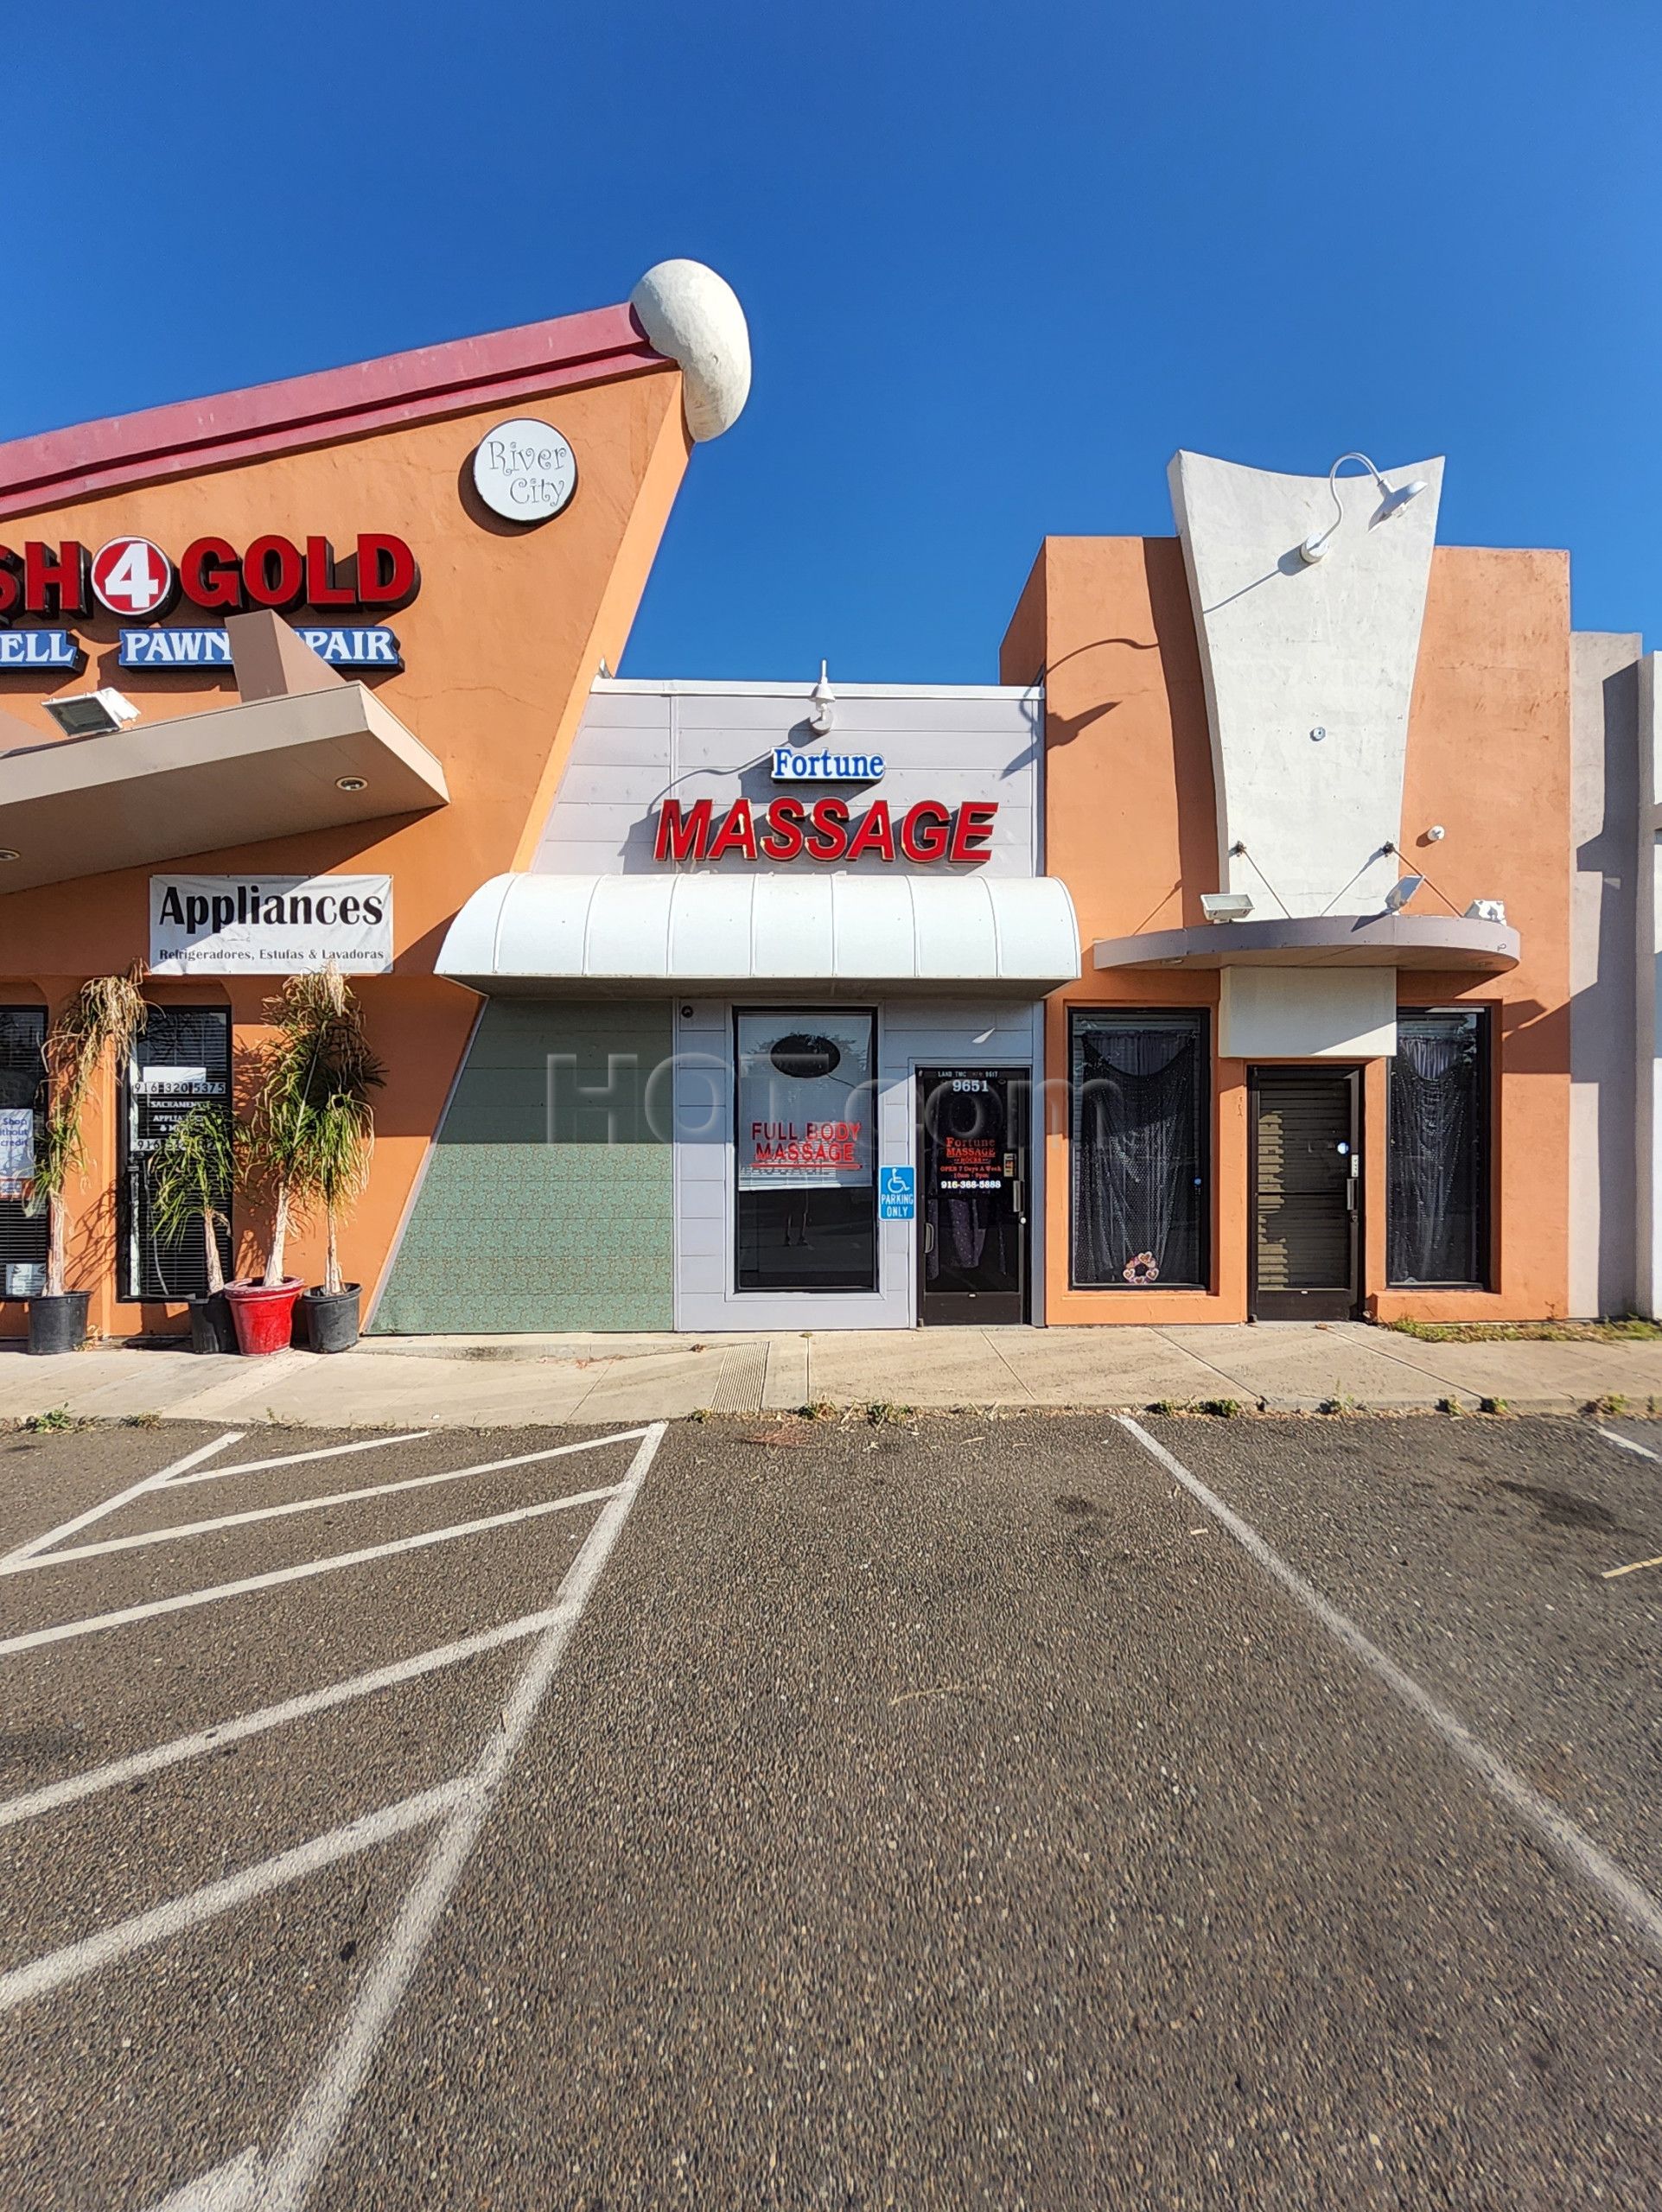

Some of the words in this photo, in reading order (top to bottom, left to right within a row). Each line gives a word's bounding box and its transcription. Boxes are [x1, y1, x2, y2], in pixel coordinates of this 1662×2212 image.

[487, 441, 568, 476] River
[509, 478, 565, 507] City
[105, 543, 159, 608] 4
[180, 534, 415, 607] GOLD
[125, 632, 232, 663] PAWN
[774, 748, 884, 778] Fortune
[653, 796, 999, 862] MASSAGE
[159, 885, 383, 934] Appliances
[159, 949, 255, 961] Refrigeradores,
[259, 949, 304, 959] Estufas
[309, 950, 316, 959] &
[322, 949, 384, 959] Lavadoras
[134, 1083, 158, 1093] 916
[165, 1083, 188, 1093] 320
[194, 1083, 225, 1093] 5375
[952, 1079, 989, 1092] 9651
[752, 1122, 798, 1141] FULL
[806, 1122, 862, 1141] BODY
[755, 1141, 856, 1161] MASSAGE
[946, 1137, 995, 1147] Fortune
[946, 1147, 996, 1156] MASSAGE
[881, 1194, 914, 1205] PARKING
[886, 1206, 908, 1217] ONLY
